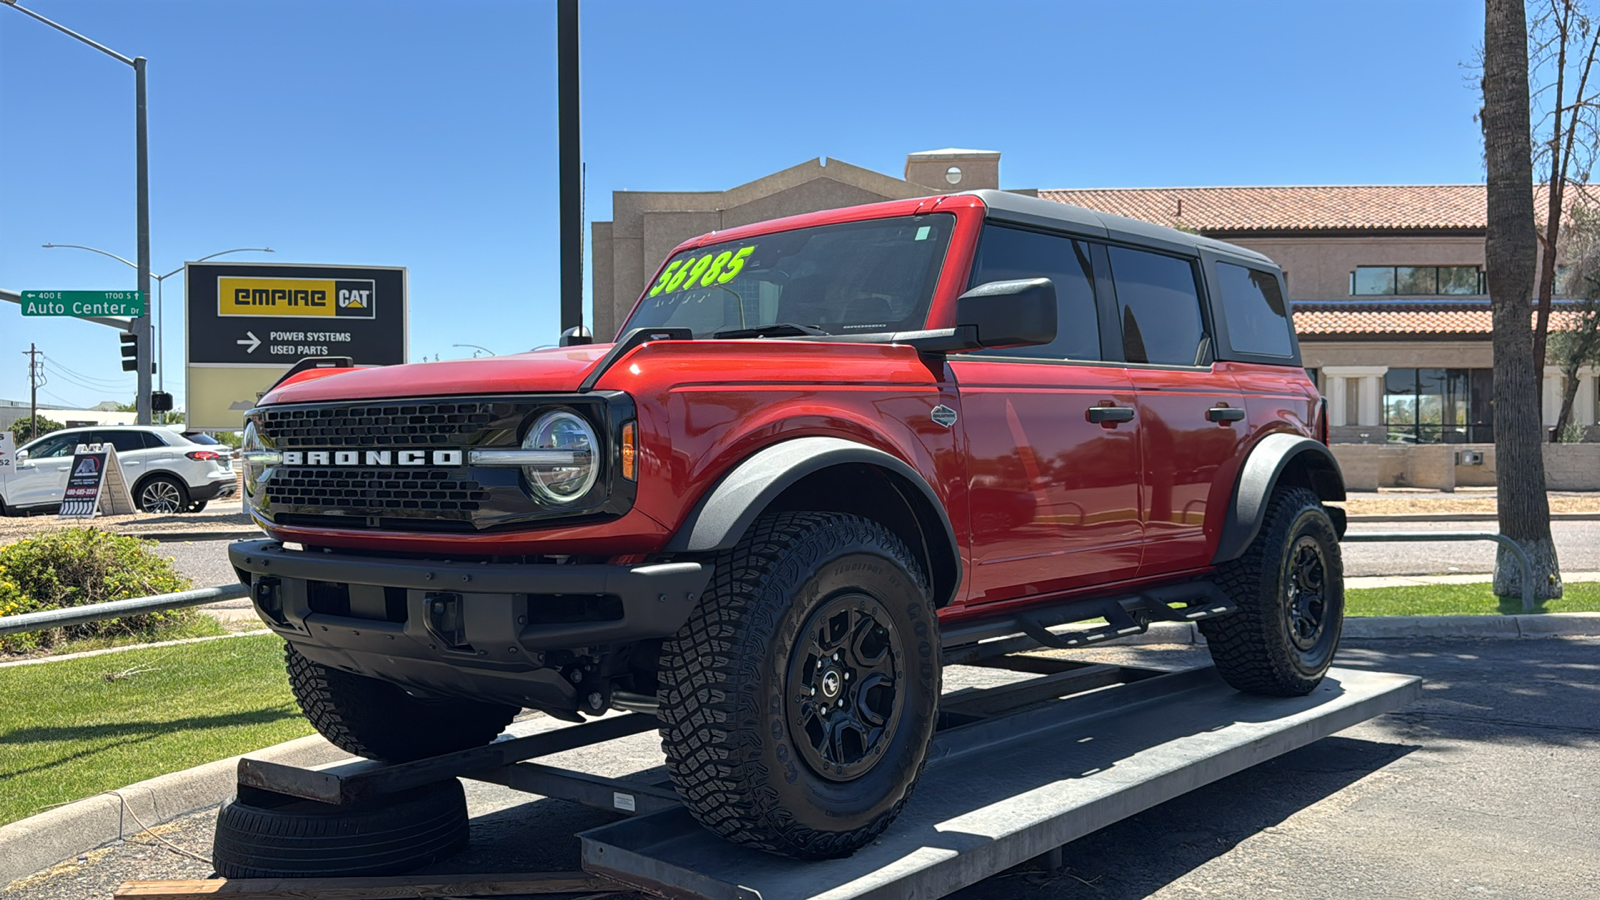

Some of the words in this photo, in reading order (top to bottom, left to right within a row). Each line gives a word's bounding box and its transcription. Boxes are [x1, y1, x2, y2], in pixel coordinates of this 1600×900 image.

[649, 245, 755, 298] 56985
[234, 288, 326, 307] EMPIRE
[338, 289, 370, 309] CAT
[26, 301, 65, 314] Auto
[72, 301, 127, 314] Center
[270, 331, 305, 342] POWER
[306, 332, 351, 342] SYSTEMS
[270, 345, 295, 355] USED
[297, 346, 328, 355] PARTS
[282, 449, 463, 466] BRONCO
